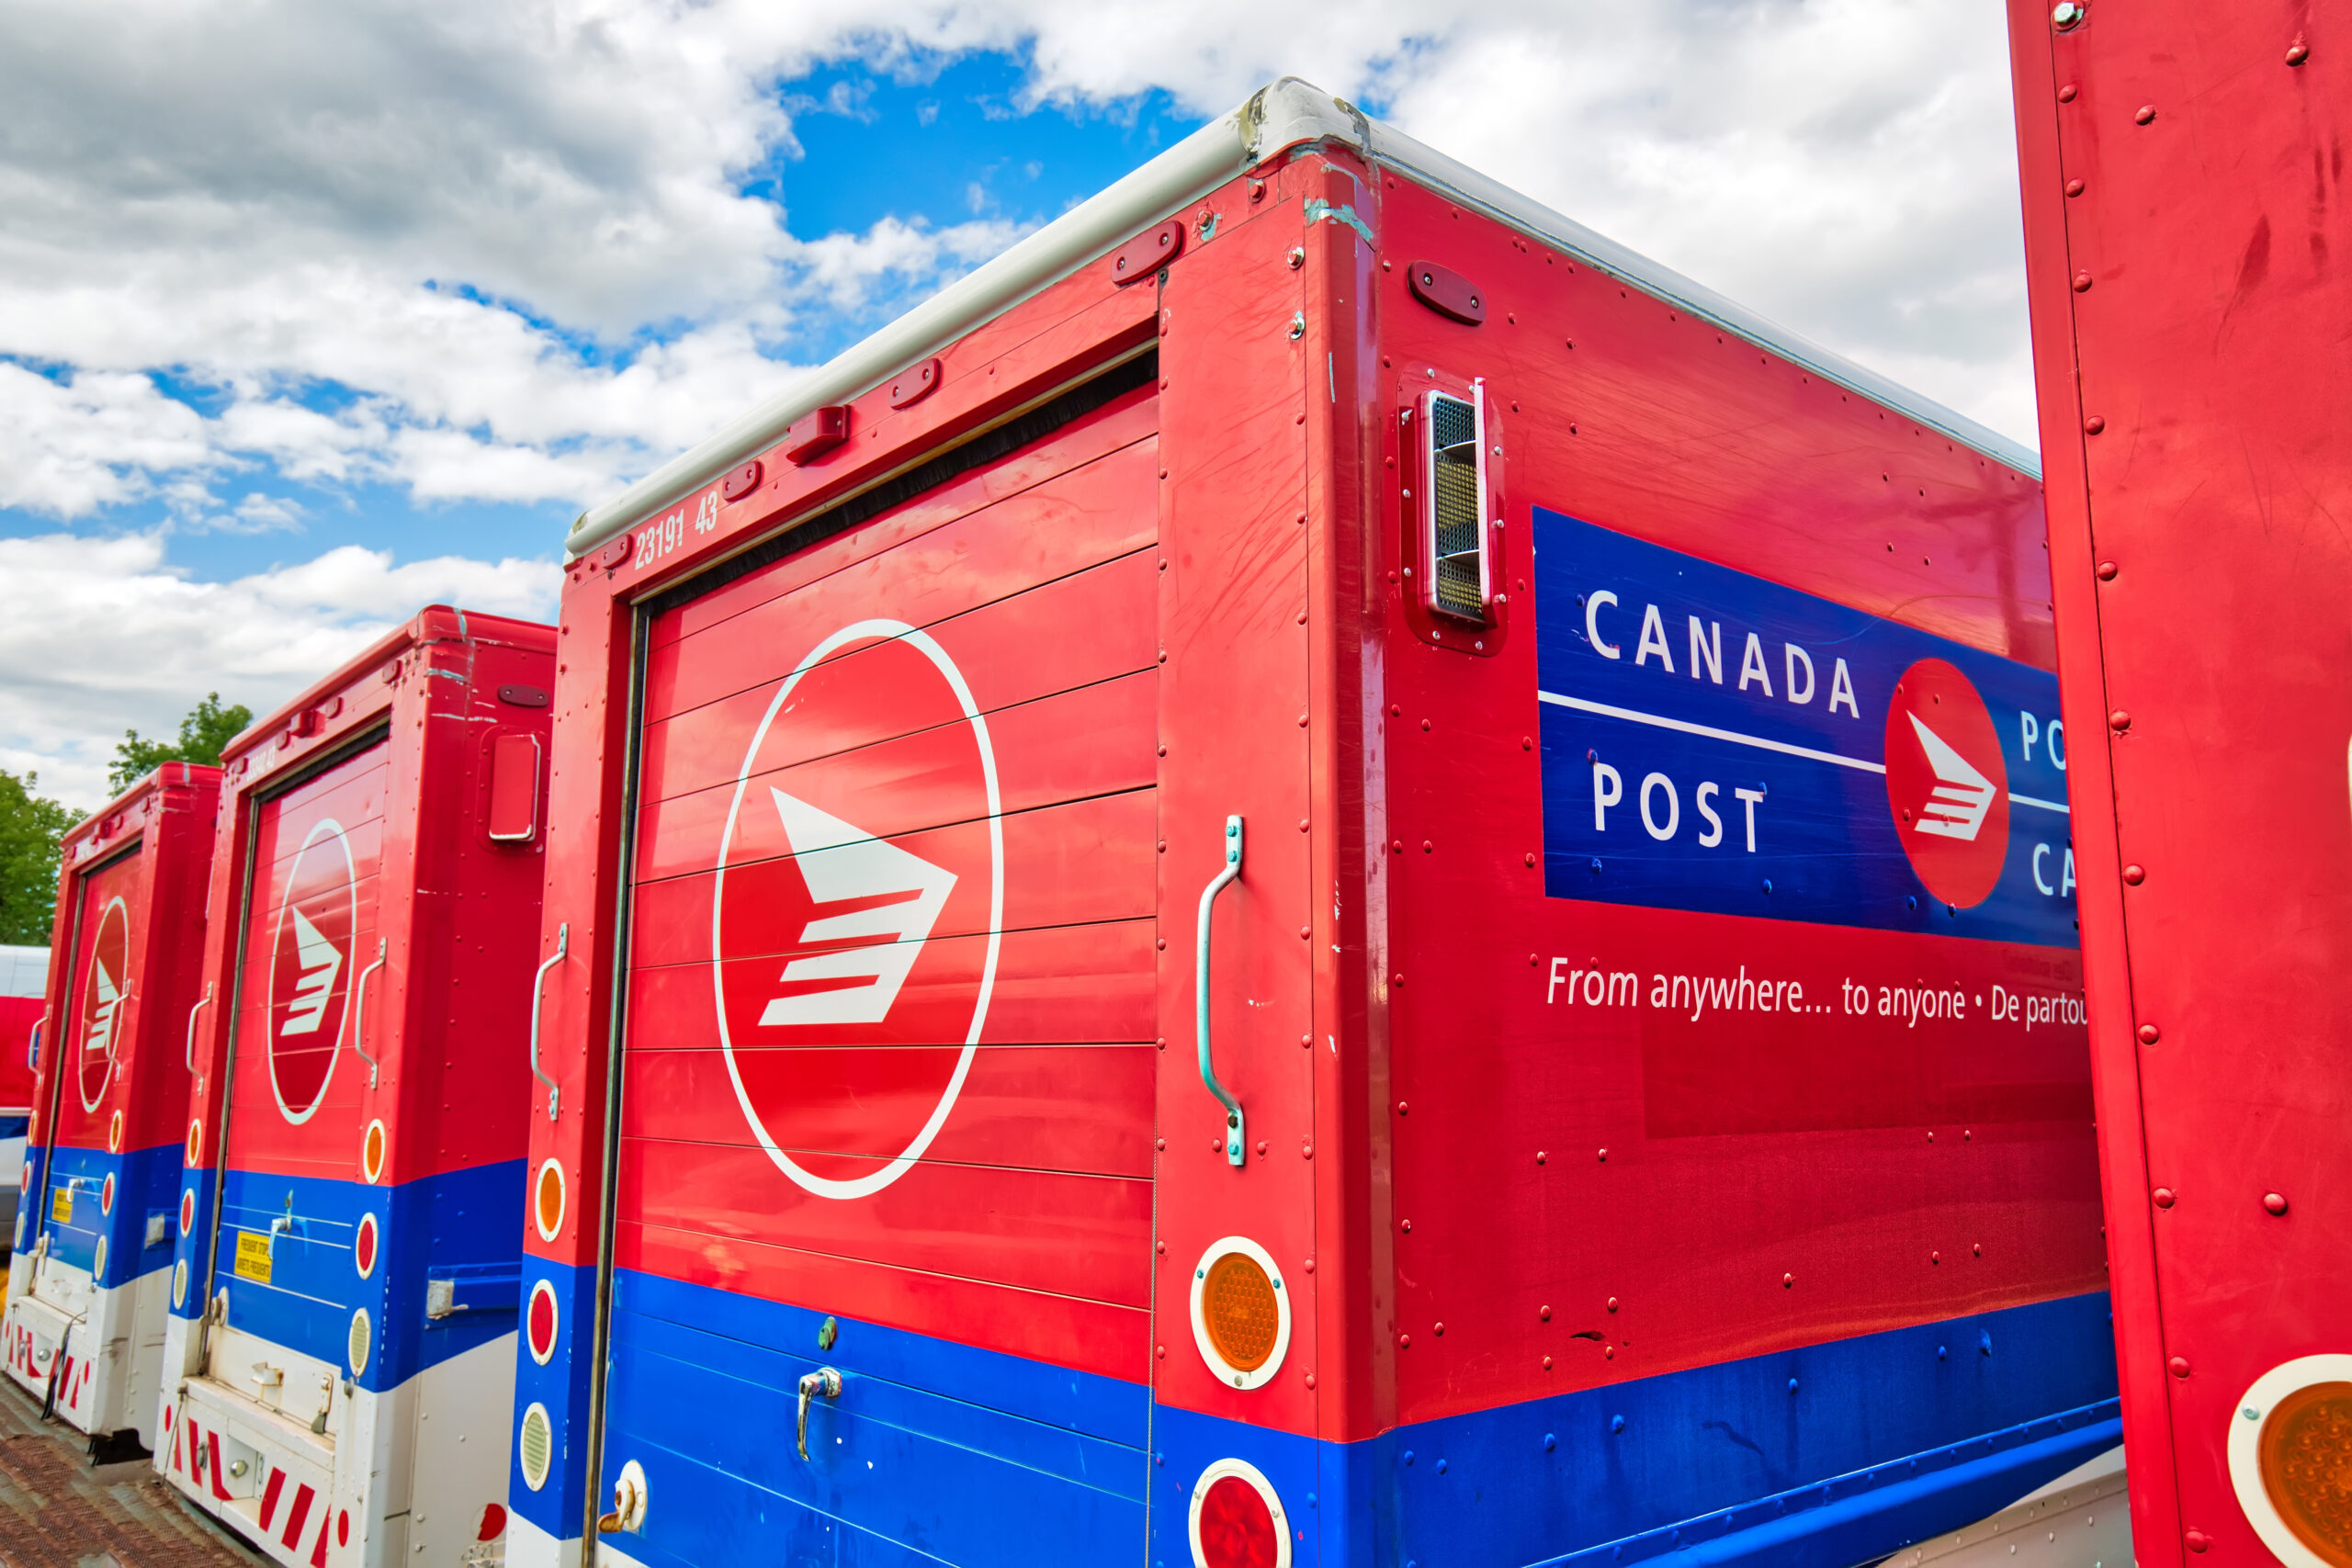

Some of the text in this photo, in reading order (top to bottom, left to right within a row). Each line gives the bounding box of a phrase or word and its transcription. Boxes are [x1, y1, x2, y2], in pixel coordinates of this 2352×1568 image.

[635, 491, 718, 570] 23191 43
[1584, 590, 1860, 719] CANADA
[1592, 761, 1765, 853] POST
[1547, 956, 1639, 1007] From
[1650, 965, 1832, 1022] anywhere...
[1842, 976, 1869, 1015] to
[1878, 985, 1965, 1028] anyone
[1992, 985, 2019, 1021] De
